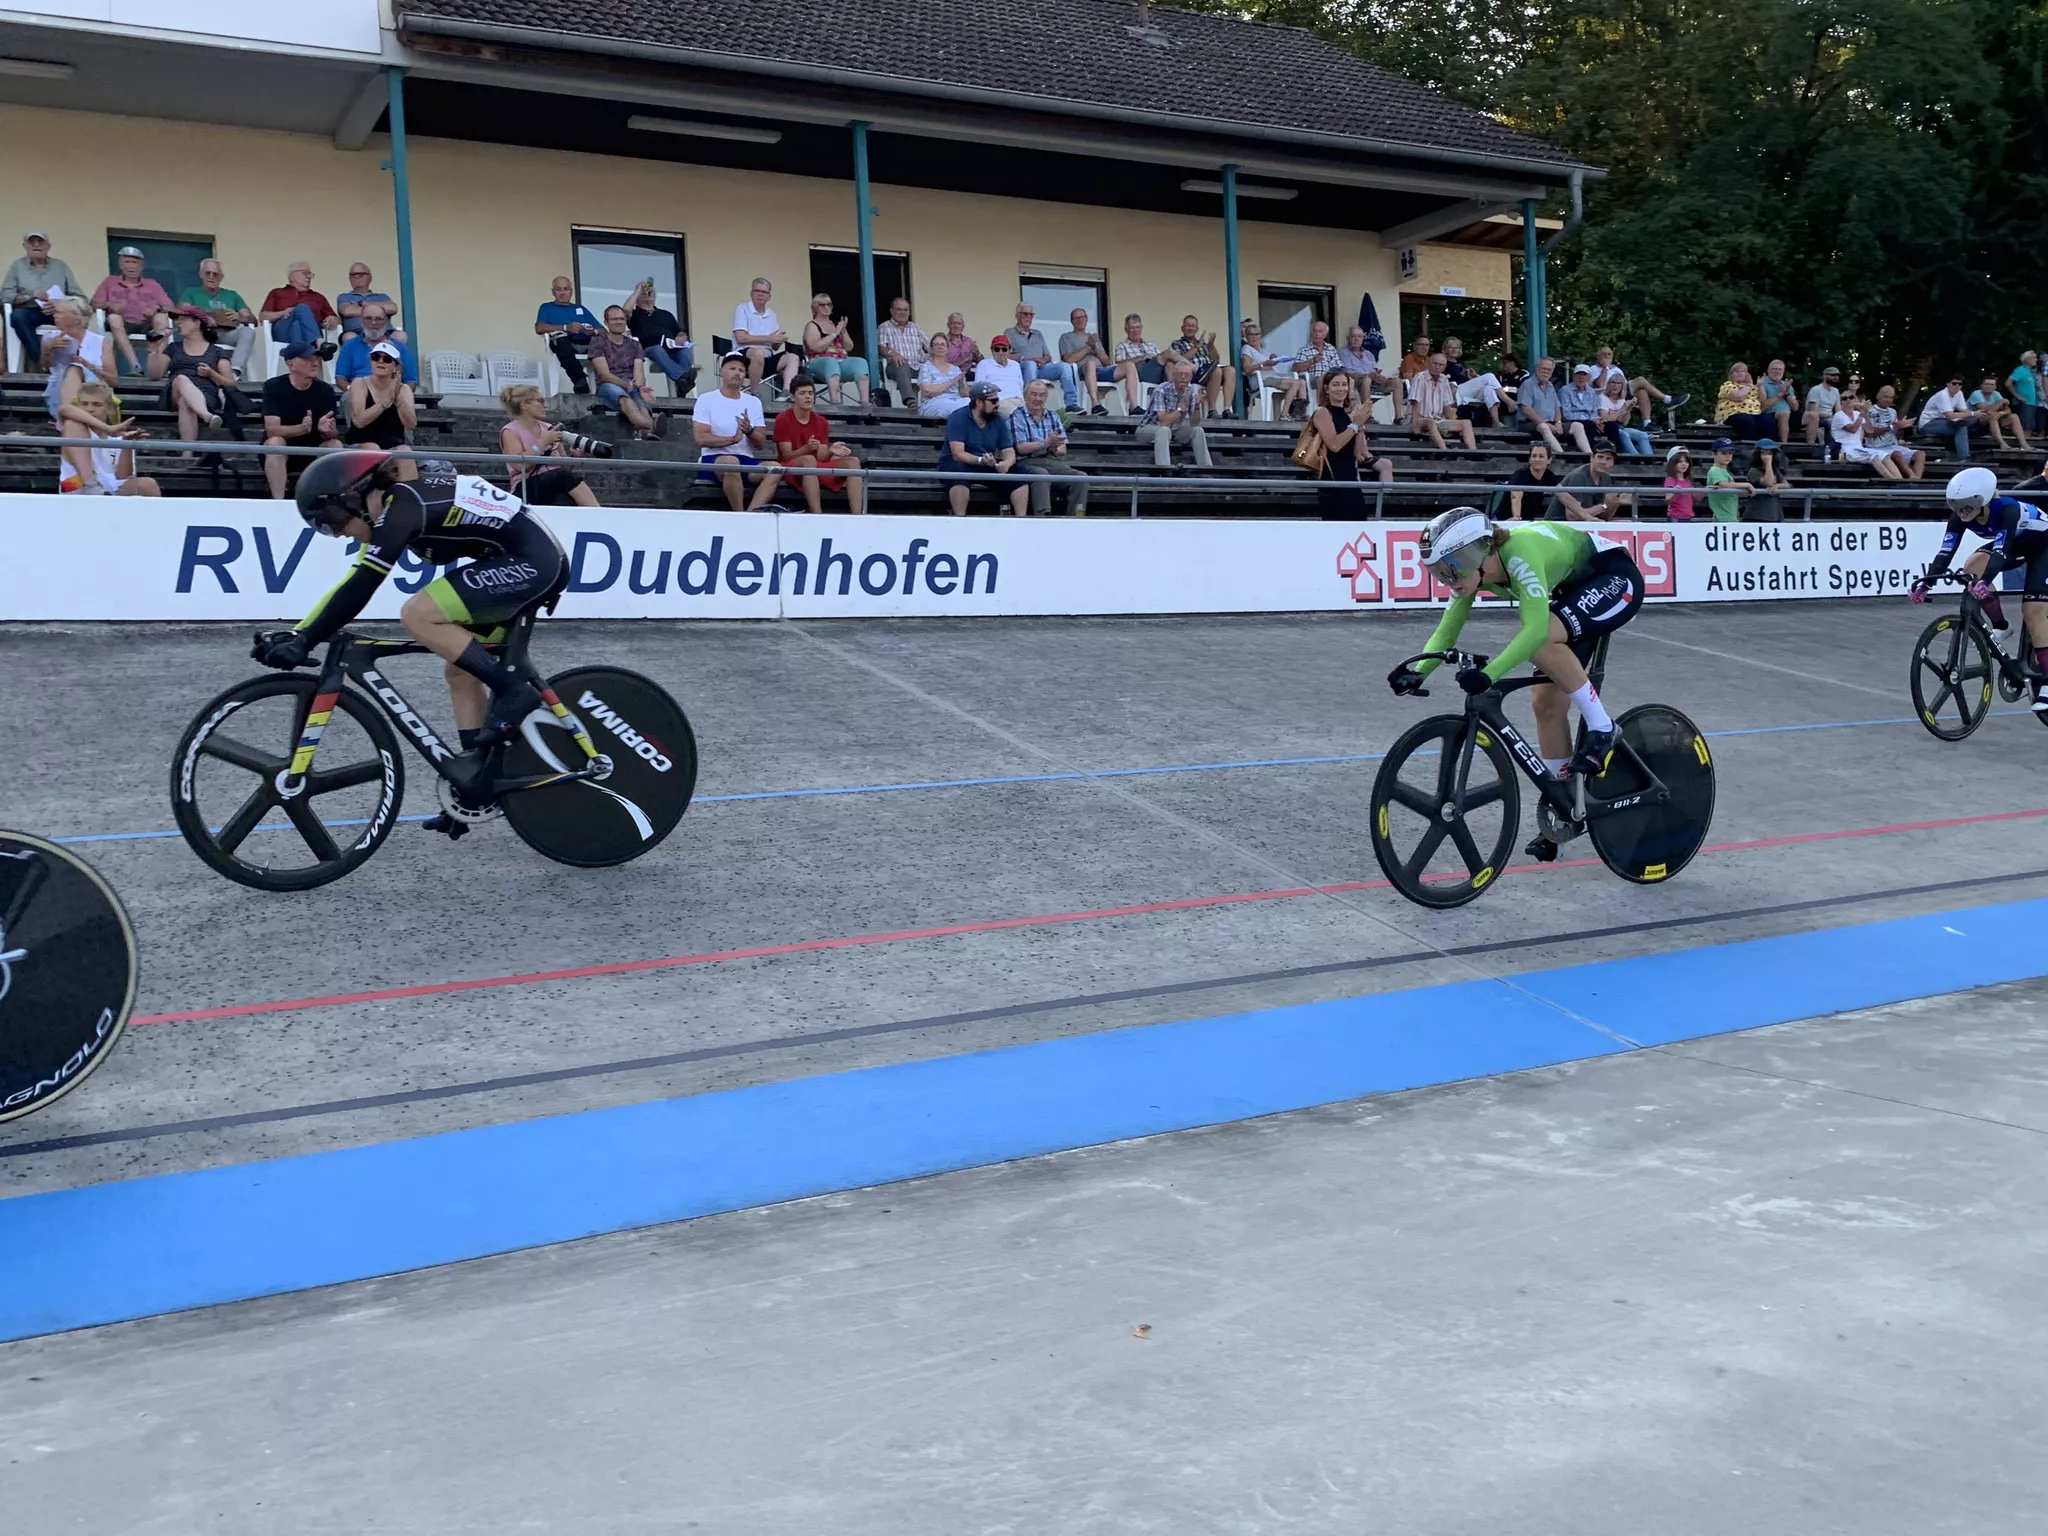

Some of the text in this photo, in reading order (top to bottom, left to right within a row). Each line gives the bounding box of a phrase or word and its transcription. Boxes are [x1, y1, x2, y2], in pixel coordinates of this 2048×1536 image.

[175, 525, 316, 593] RV
[567, 531, 999, 596] Dudenhofen
[1705, 525, 1907, 552] direkt an der B9
[462, 562, 539, 590] Genesis
[1706, 565, 1818, 592] Ausfahrt
[362, 670, 456, 763] LOOK
[577, 689, 673, 773] CORIMA
[1500, 725, 1546, 776] FES
[354, 748, 395, 851] CORIMA
[0, 1006, 113, 1109] GNOLO
